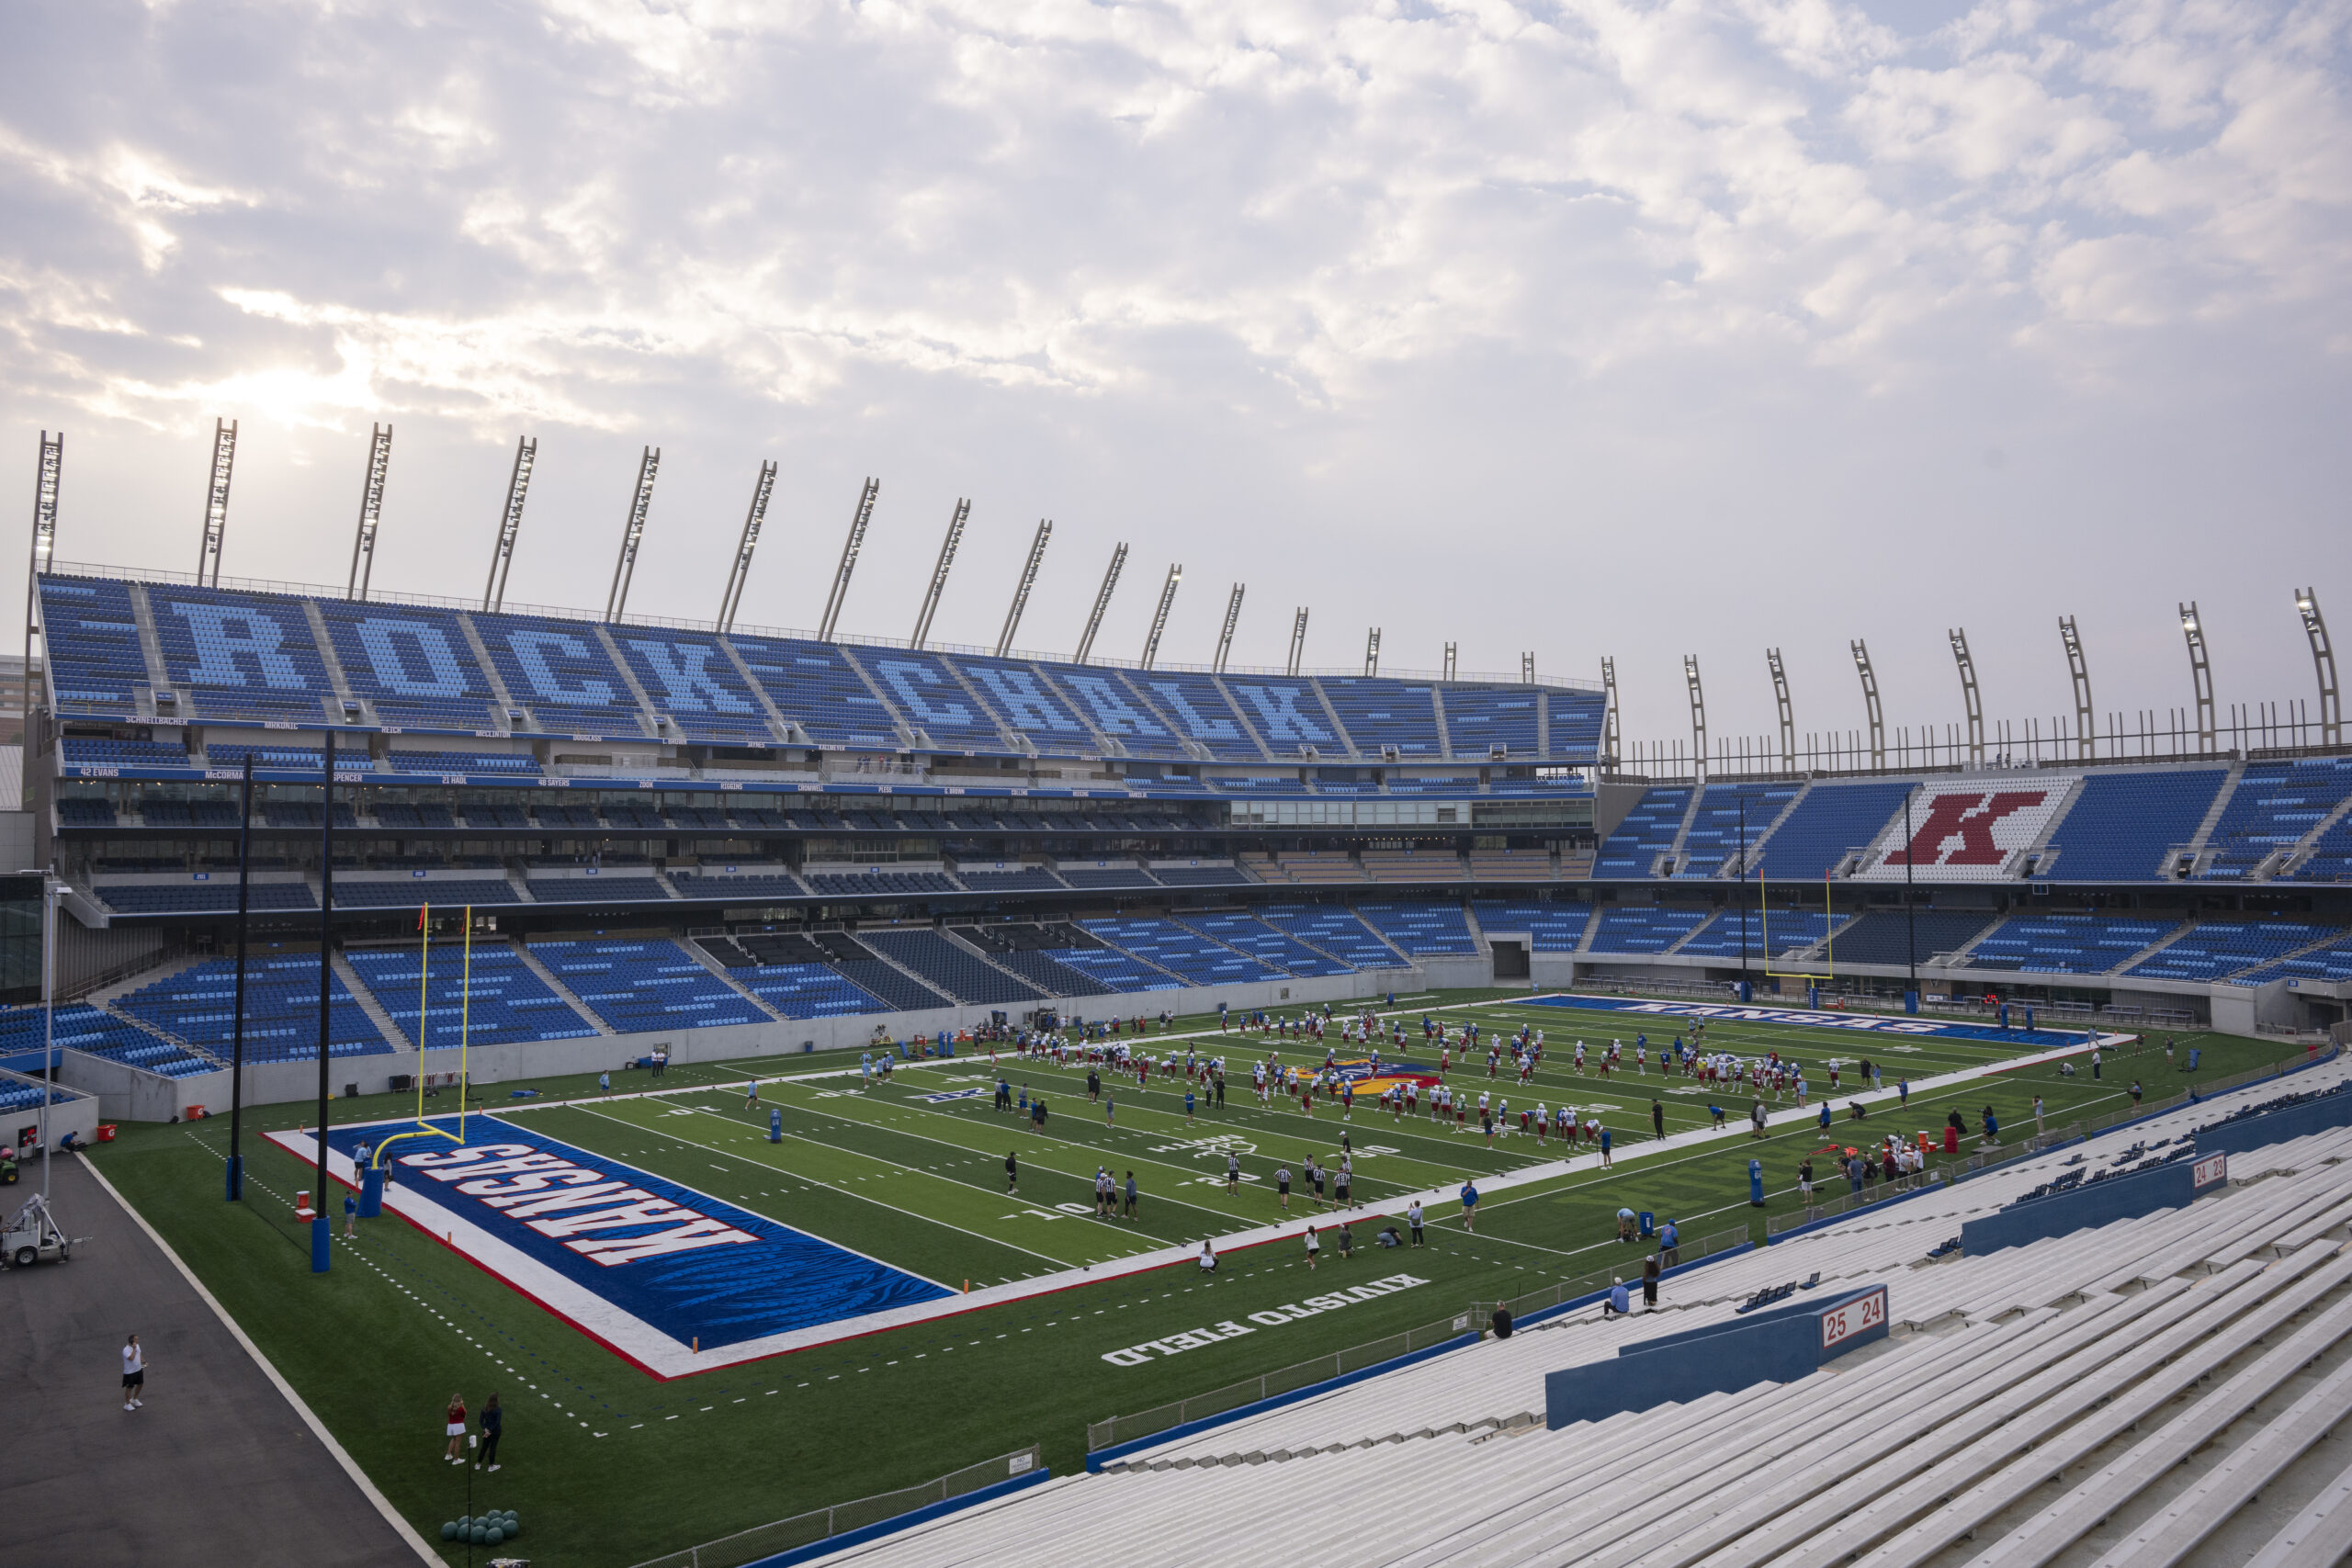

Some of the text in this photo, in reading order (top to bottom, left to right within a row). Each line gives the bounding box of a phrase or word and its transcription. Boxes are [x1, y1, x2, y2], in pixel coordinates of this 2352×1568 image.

[171, 602, 1333, 740] ROCK CHALK
[125, 716, 188, 726] SCHNELLBACHER
[264, 721, 299, 730] MRKONIC
[572, 734, 602, 742] DOUGLASS
[80, 767, 119, 777] 42 EVANS
[442, 776, 450, 784] 21
[538, 778, 570, 787] 48 SAYERS
[1623, 1003, 1949, 1032] KANSAS
[2197, 1159, 2222, 1183] 24 23
[395, 1144, 764, 1267] KANSAS
[1022, 1202, 1095, 1221] 10
[1101, 1273, 1431, 1366] KIVISTO FIELD
[1826, 1297, 1881, 1341] 25 24
